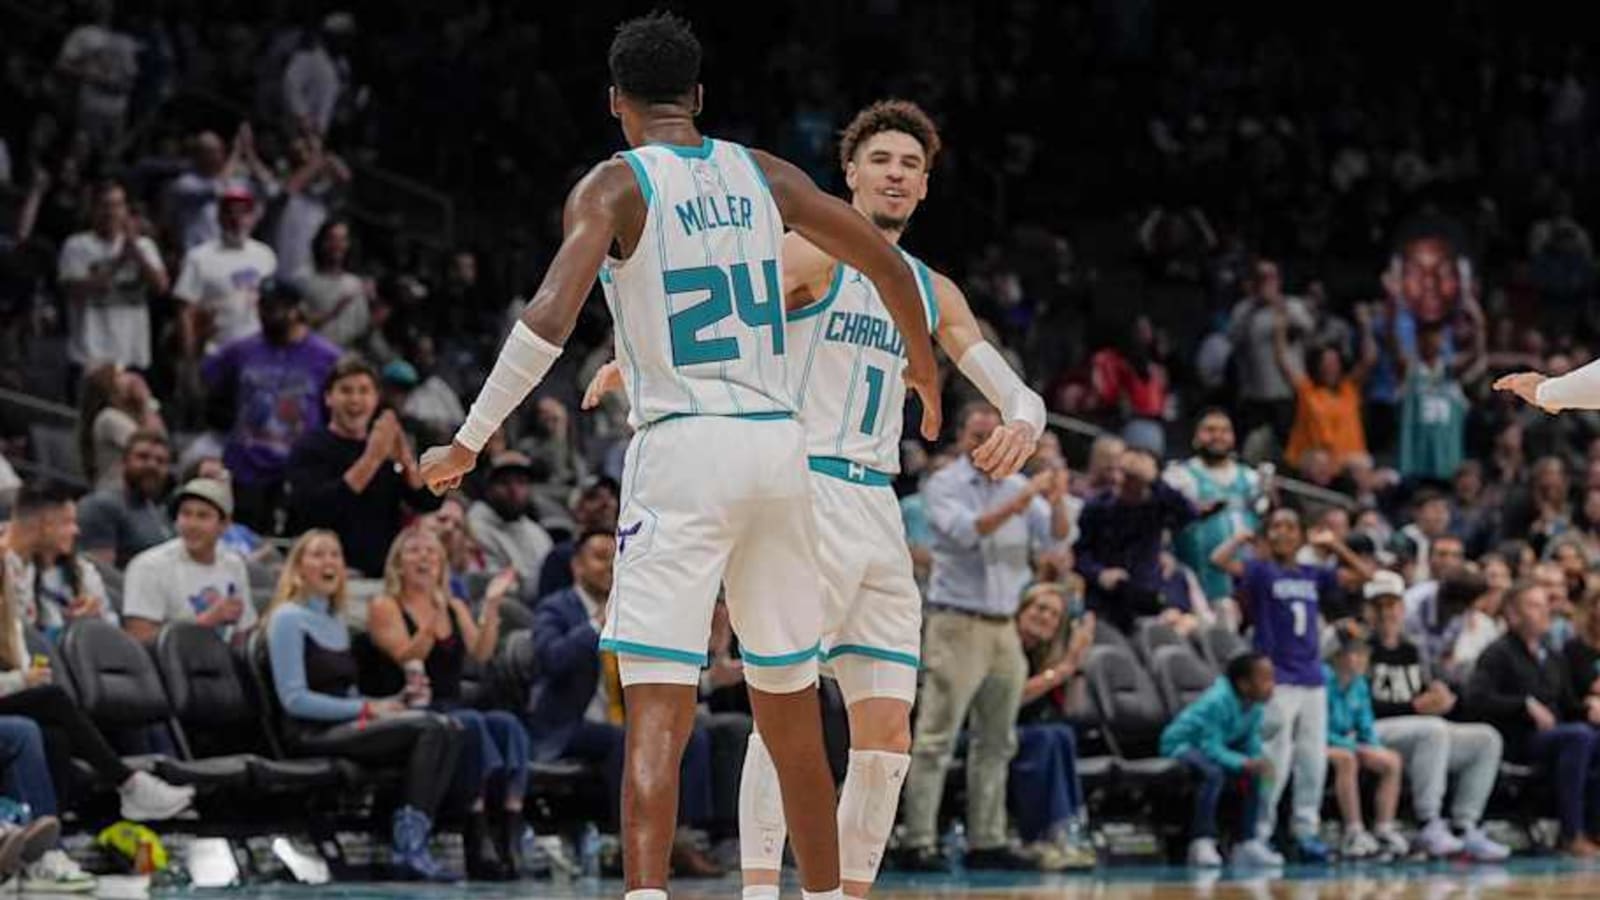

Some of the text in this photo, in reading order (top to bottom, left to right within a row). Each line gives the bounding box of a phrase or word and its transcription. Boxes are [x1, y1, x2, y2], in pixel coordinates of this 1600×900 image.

[675, 196, 753, 236] MILLER
[663, 259, 785, 367] 24
[825, 311, 907, 359] CHARLO
[859, 365, 885, 436] 1
[1291, 601, 1308, 637] 1
